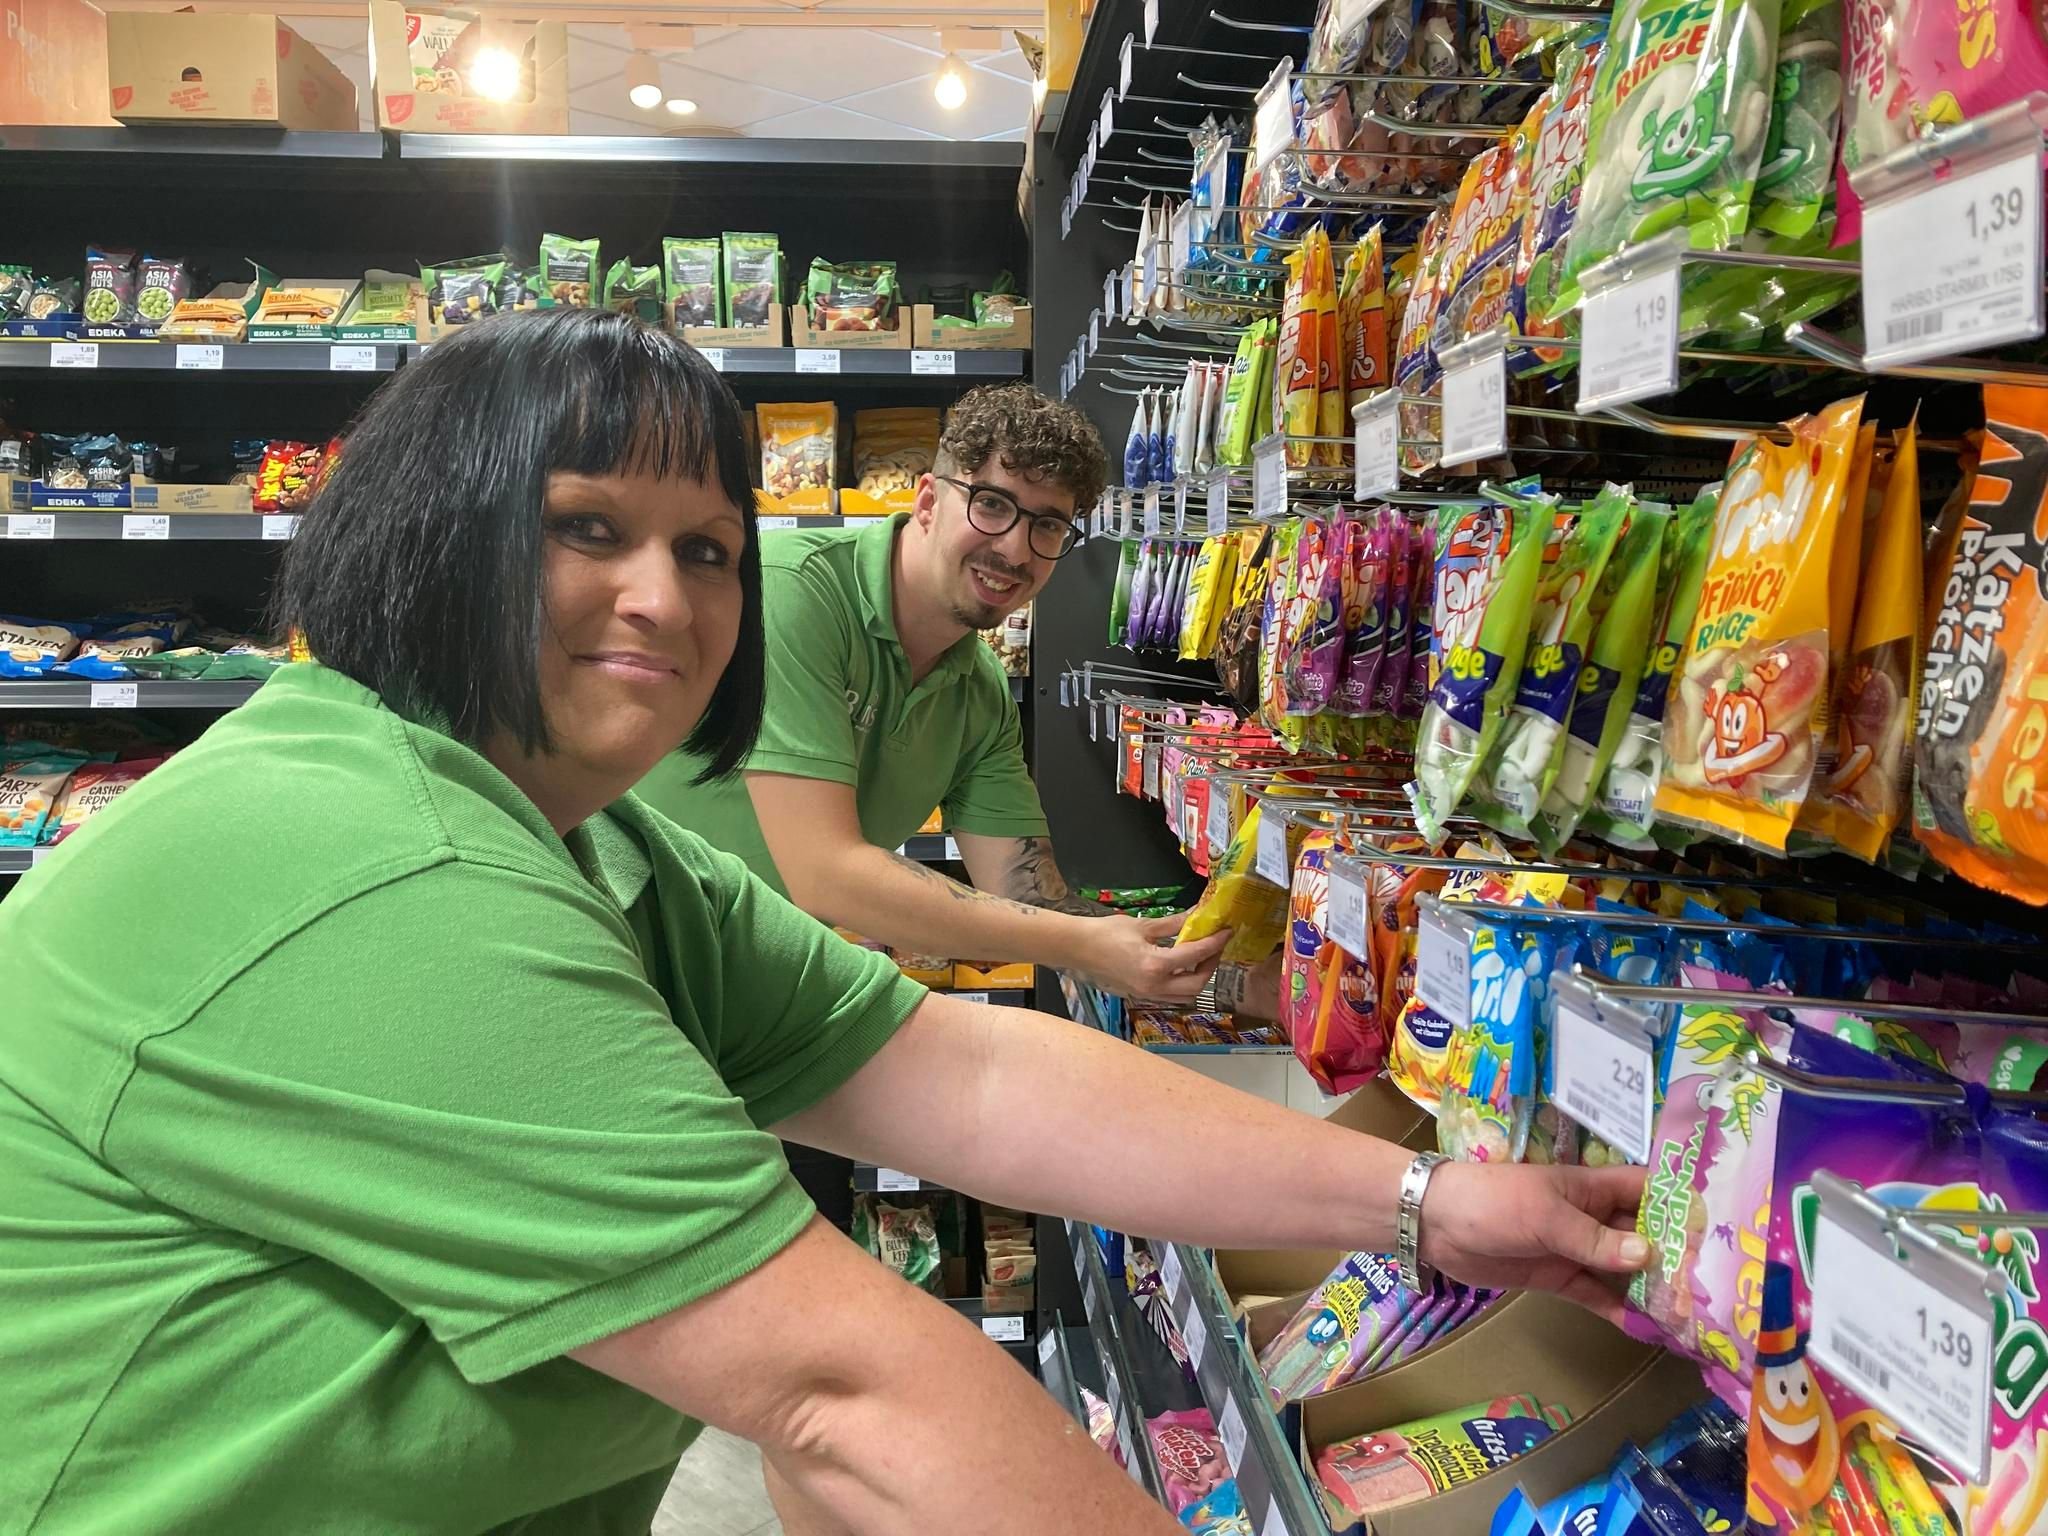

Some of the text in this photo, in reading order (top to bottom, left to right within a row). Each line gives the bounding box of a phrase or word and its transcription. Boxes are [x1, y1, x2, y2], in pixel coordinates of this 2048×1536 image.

[1965, 186, 2024, 243] 1,39
[90, 270, 113, 280] ASIA
[145, 270, 170, 280] ASIA
[1633, 296, 1666, 330] 1,19
[88, 328, 126, 337] EDEKA
[205, 349, 220, 358] 1,19
[357, 351, 373, 359] 1,19
[933, 354, 953, 362] 0,99
[88, 467, 121, 475] CASHEW
[47, 498, 86, 506] EDEKA
[1916, 528, 1985, 738] Pfötchen
[1936, 531, 2025, 738] Katzen
[1612, 1058, 1645, 1096] 2,29
[1645, 1138, 1685, 1244] LAND
[1915, 1306, 1973, 1368] 1,39
